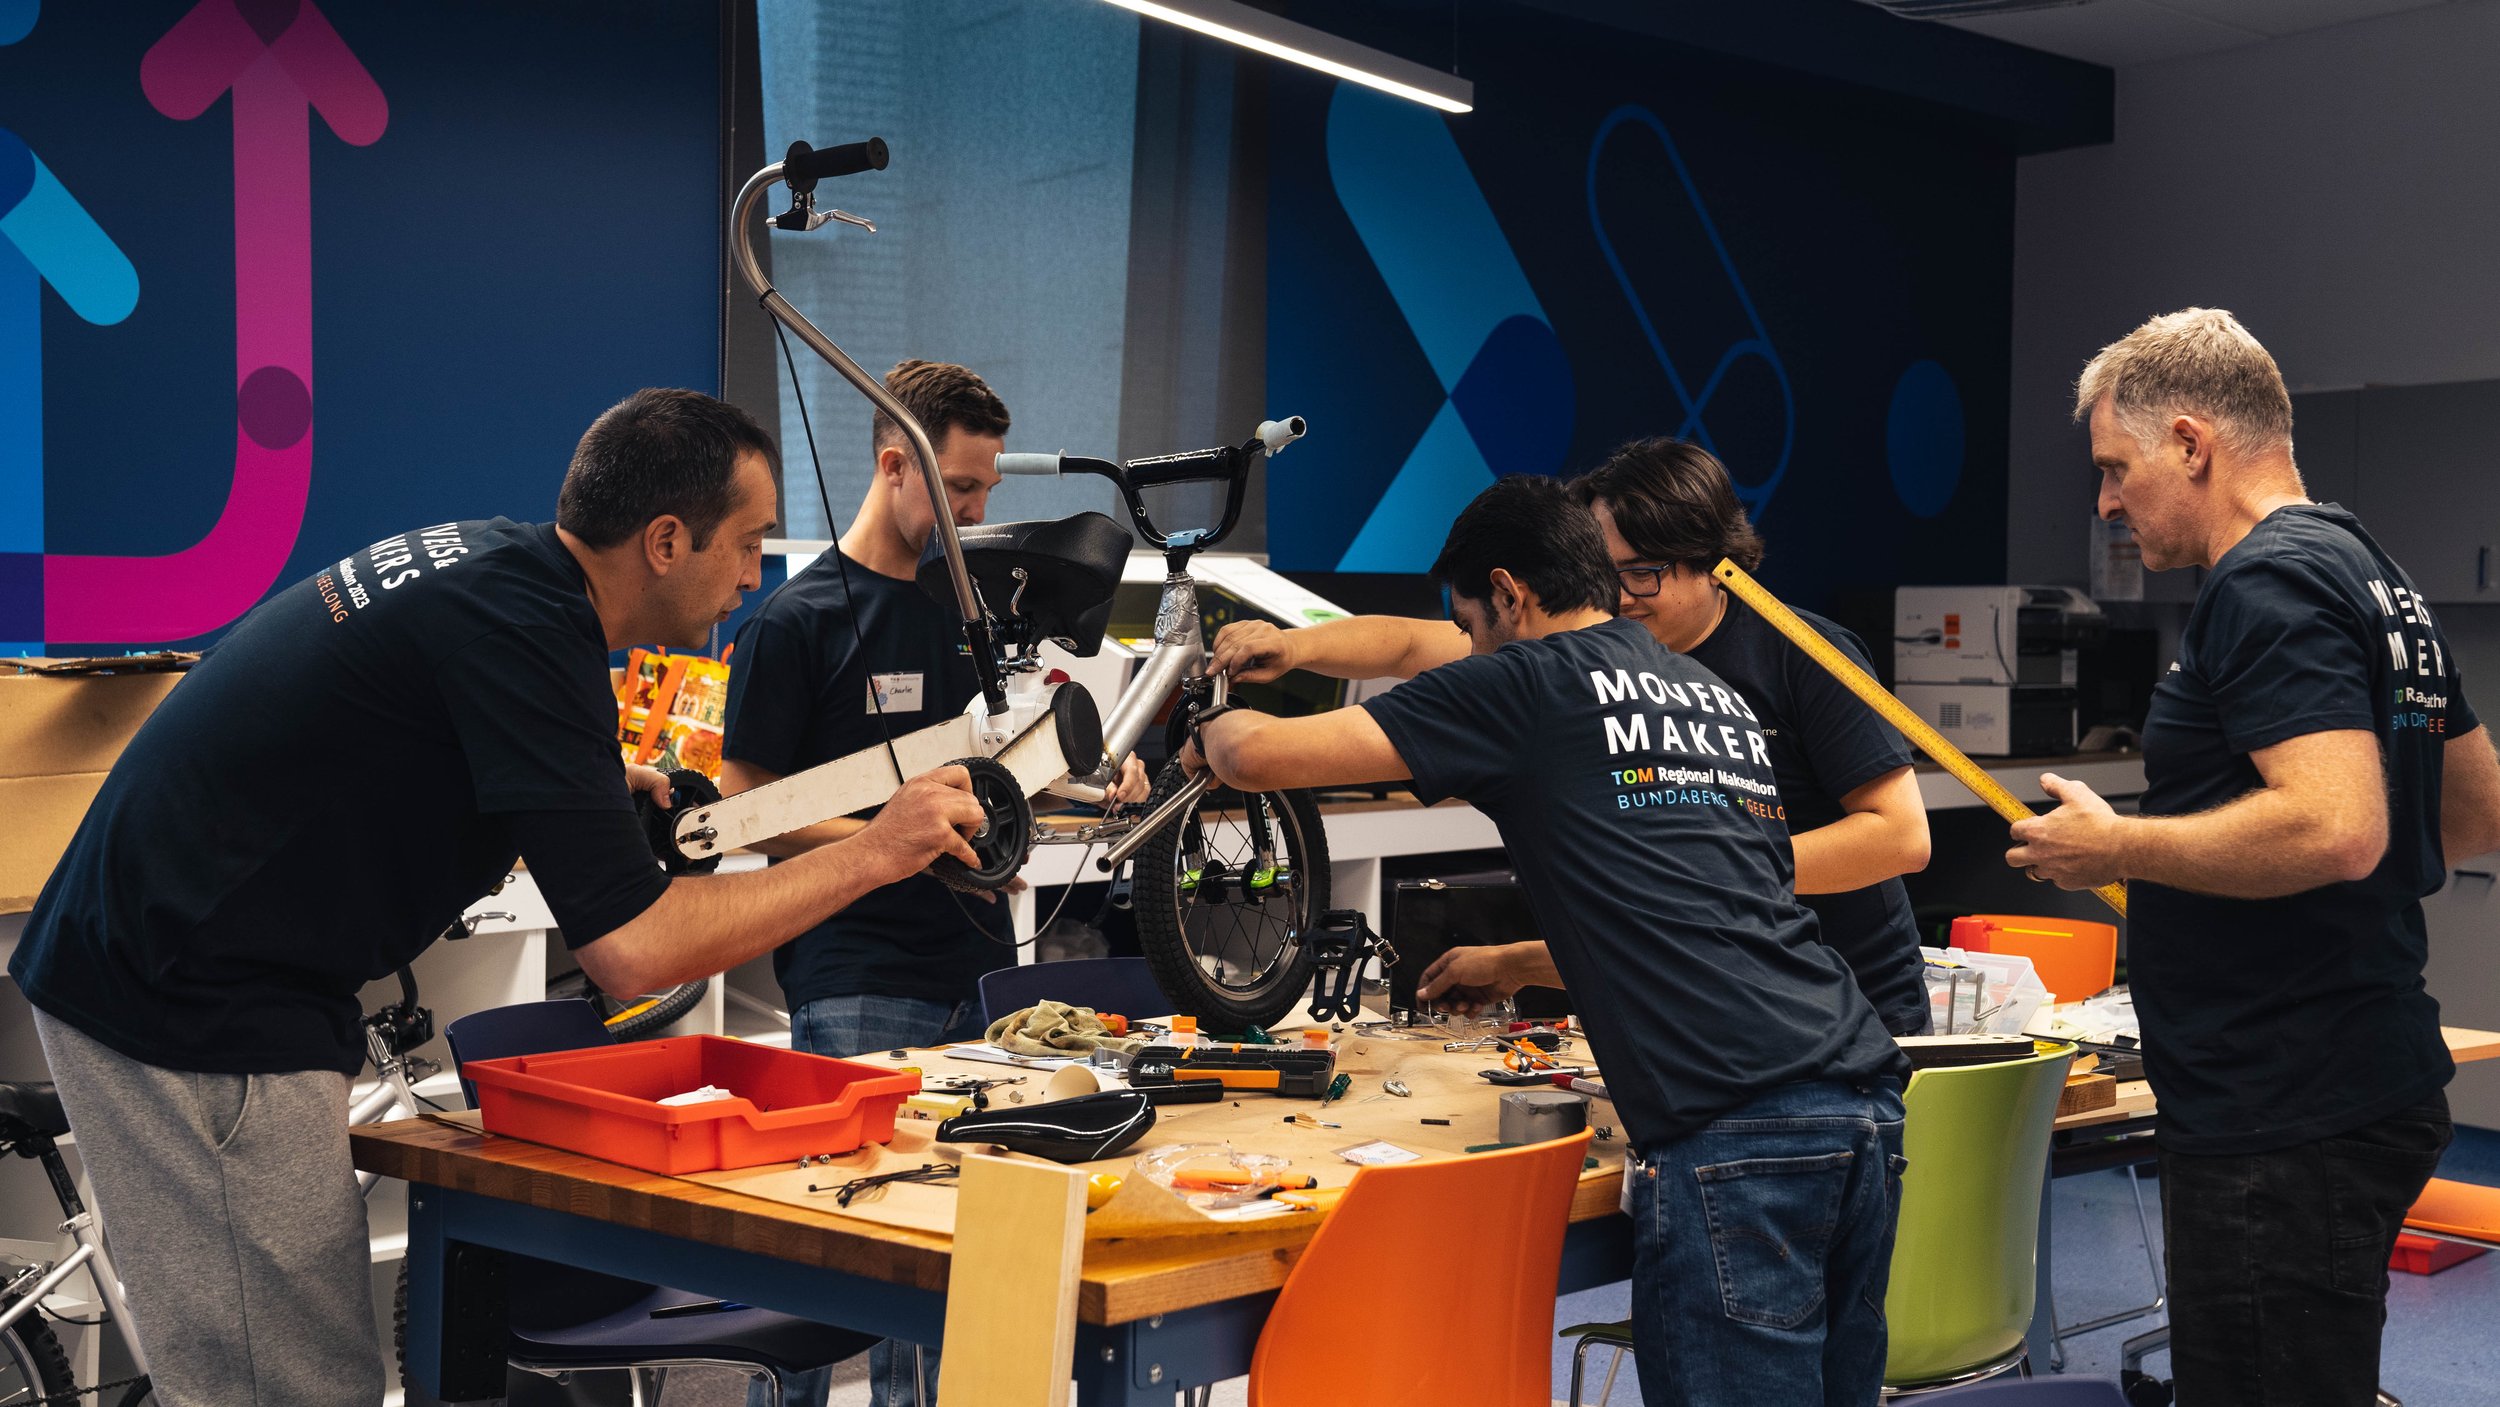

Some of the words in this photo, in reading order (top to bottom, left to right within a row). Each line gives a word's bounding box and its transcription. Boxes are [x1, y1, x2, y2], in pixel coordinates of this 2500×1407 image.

[433, 557, 459, 570] &
[348, 583, 370, 609] 2023
[1590, 669, 1758, 723] MOVERS
[1603, 713, 1772, 767] MAKER
[1611, 767, 1654, 785] TOM
[1657, 766, 1714, 785] Regional
[1717, 770, 1776, 796] Makeathon
[1617, 789, 1729, 809] BUNDABERG
[1746, 798, 1786, 820] GEELO
